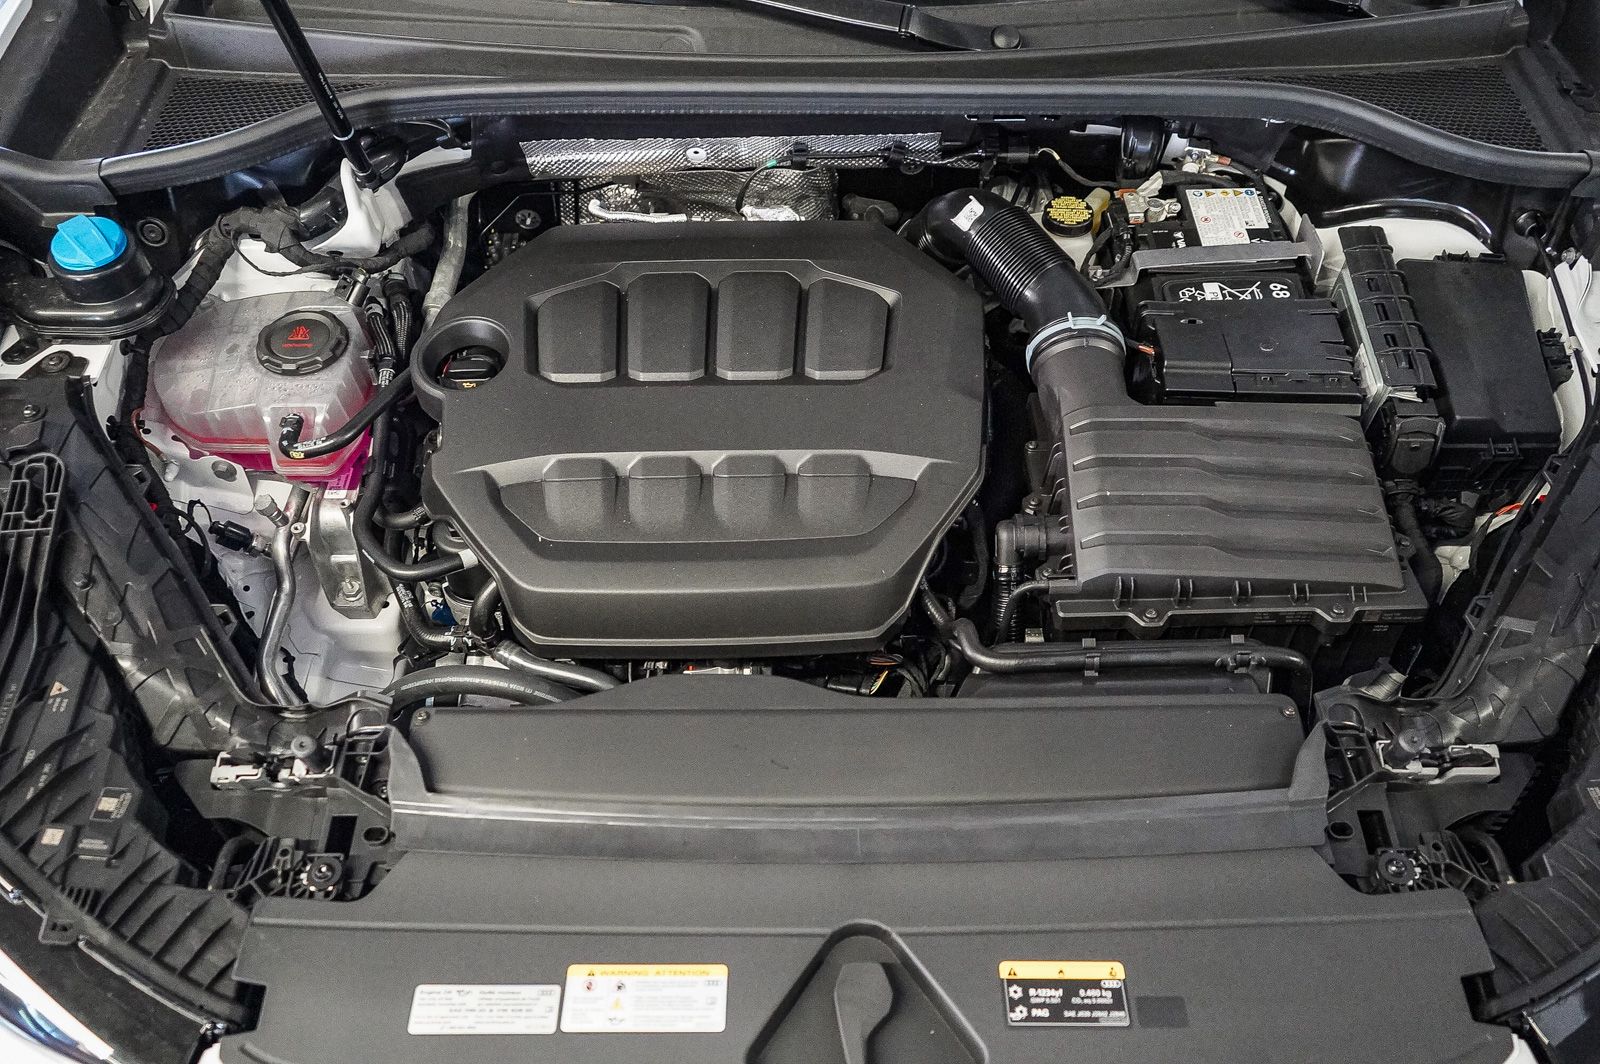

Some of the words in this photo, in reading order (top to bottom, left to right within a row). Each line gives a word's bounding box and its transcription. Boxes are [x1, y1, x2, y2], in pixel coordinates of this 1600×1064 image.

[1269, 283, 1290, 298] 68
[1028, 988, 1063, 998] R-1234yf
[1101, 988, 1112, 999] kg
[1031, 1008, 1050, 1018] PAG
